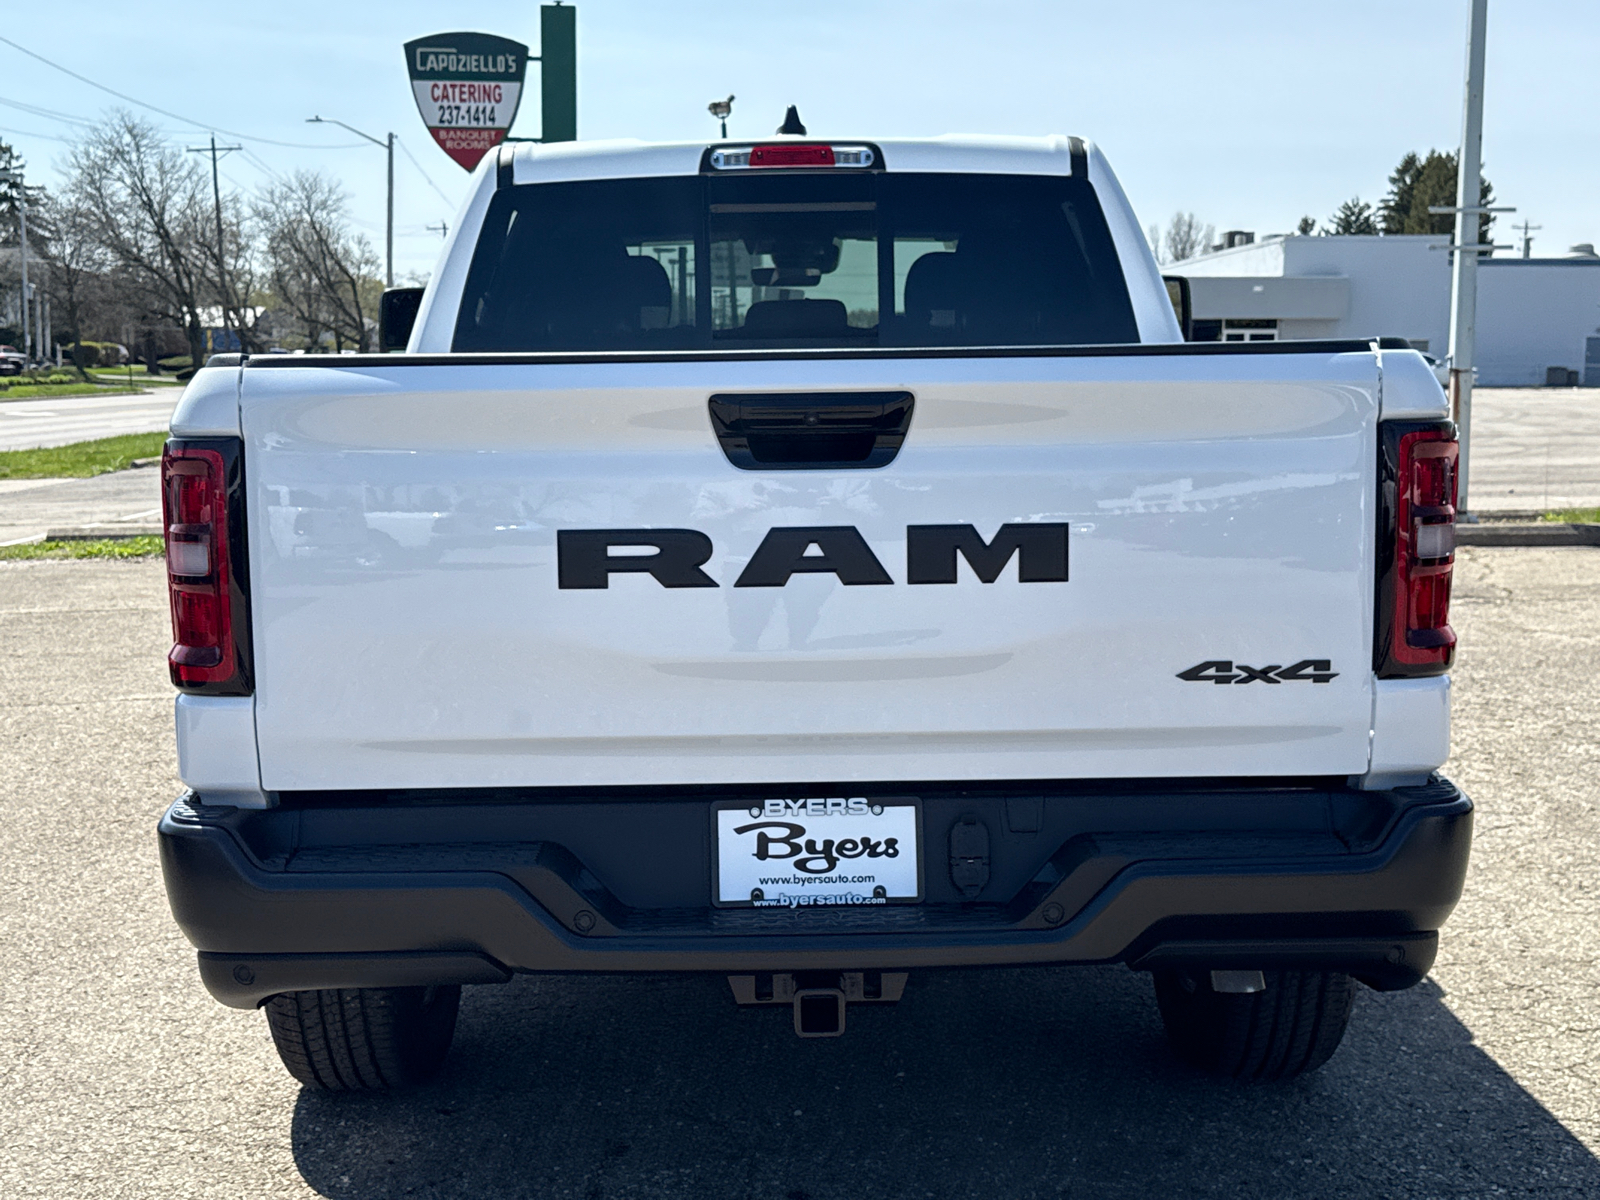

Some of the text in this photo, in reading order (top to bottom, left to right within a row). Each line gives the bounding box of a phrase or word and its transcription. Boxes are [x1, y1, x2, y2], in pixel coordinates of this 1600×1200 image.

[416, 48, 516, 72] CAPOZIELLO'S
[431, 83, 502, 103] CATERING
[439, 130, 495, 140] BANQUET
[445, 140, 490, 150] ROOMS
[557, 522, 1069, 589] RAM
[1175, 659, 1340, 684] 4x4
[764, 798, 868, 817] BYERS
[733, 821, 899, 874] Byers
[759, 874, 875, 887] www.byersauto.com
[753, 892, 886, 908] www.byersauto.com
